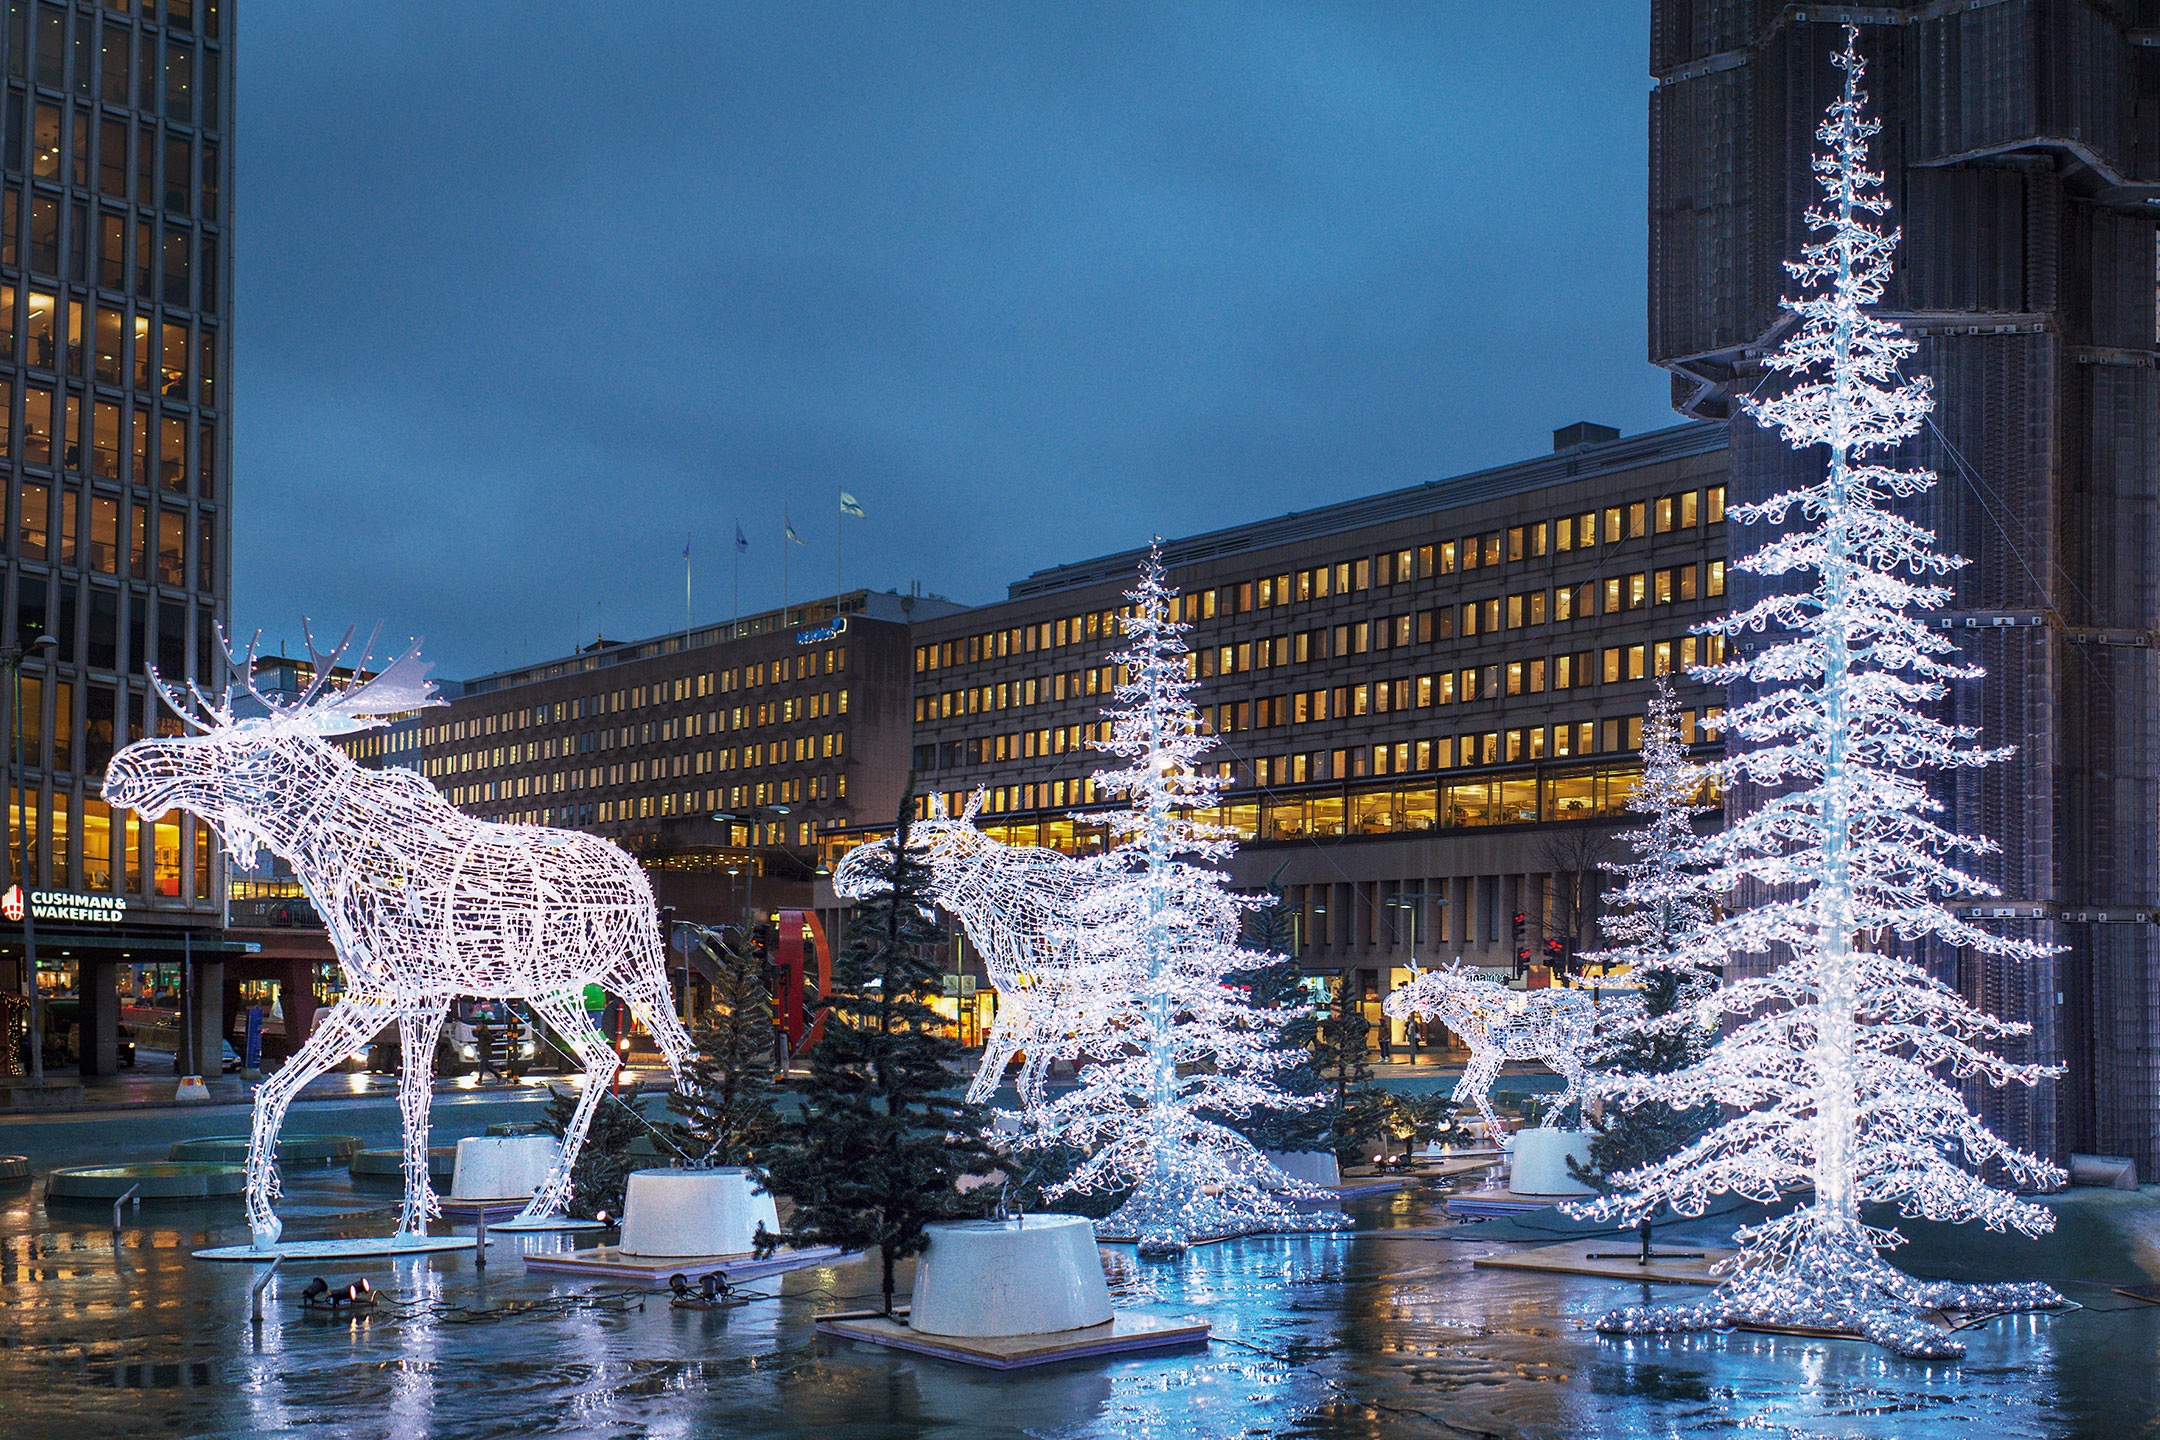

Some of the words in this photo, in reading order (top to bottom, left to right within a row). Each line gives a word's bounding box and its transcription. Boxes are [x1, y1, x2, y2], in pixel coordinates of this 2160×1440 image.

[31, 891, 113, 909] CUSHMAN
[114, 897, 127, 910] &
[31, 905, 123, 922] WAKEFIELD
